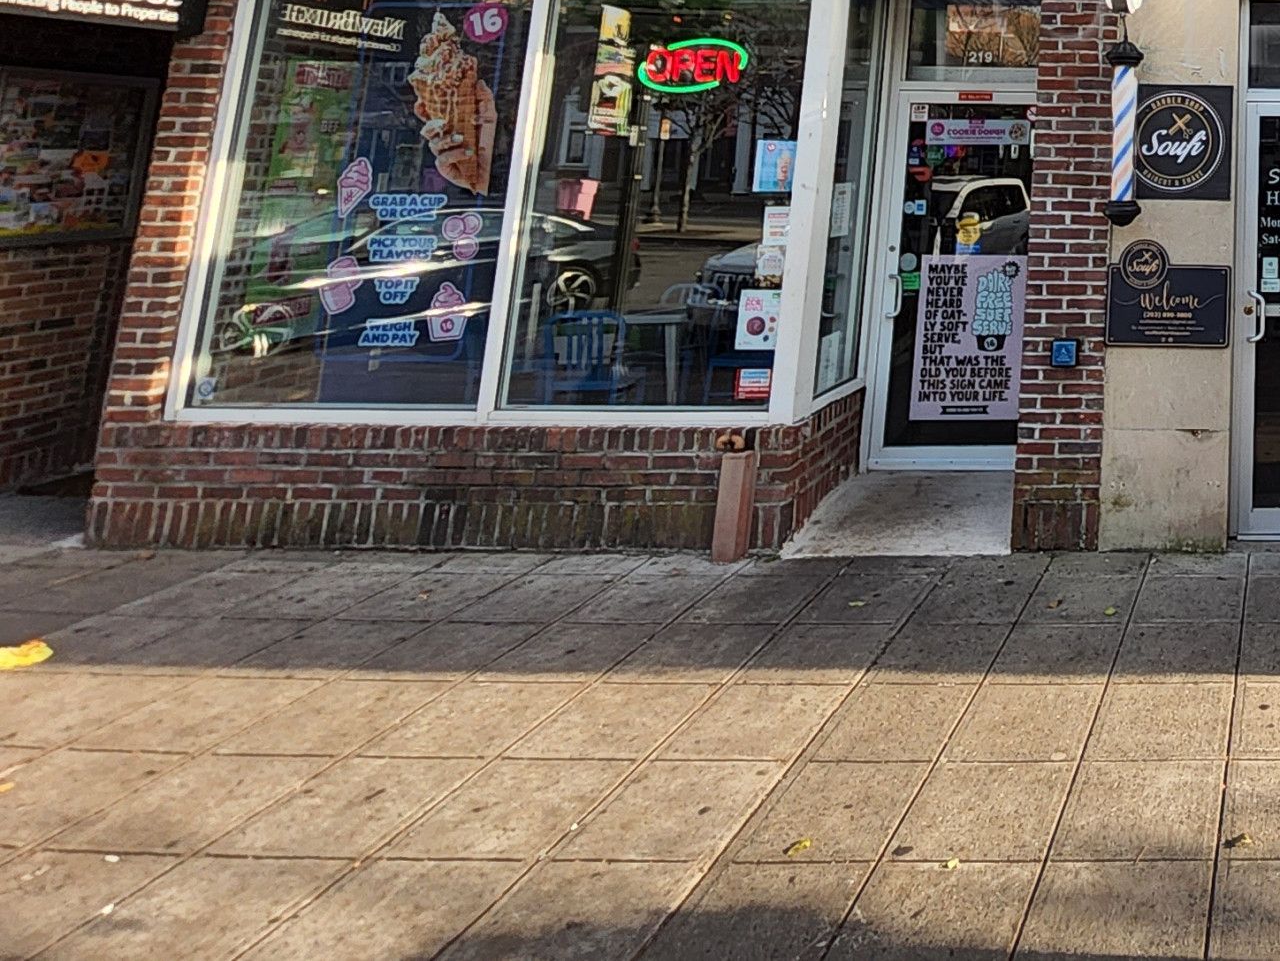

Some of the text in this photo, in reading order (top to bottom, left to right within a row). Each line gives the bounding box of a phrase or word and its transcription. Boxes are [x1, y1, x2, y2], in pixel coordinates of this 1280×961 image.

[104, 3, 119, 15] to
[121, 2, 179, 22] Properties
[469, 8, 503, 36] 16
[968, 50, 993, 64] 219
[646, 47, 740, 84] OPEN
[1141, 129, 1207, 164] Soufi
[372, 197, 445, 207] GRAB A CUP
[379, 208, 397, 218] OR
[370, 239, 435, 249] PICK YOUR
[372, 250, 430, 260] FLAVORS
[928, 264, 968, 275] MAYBE
[377, 279, 416, 289] TOP IT
[928, 275, 968, 286] YOU'VE
[382, 291, 409, 301] OFF
[926, 287, 963, 297] NEVER
[1140, 280, 1200, 311] Welcome
[925, 298, 962, 309] HEARD
[976, 290, 1012, 309] FREE
[925, 310, 968, 320] OF OAT-
[367, 321, 412, 332] WEIGH
[924, 321, 969, 332] LY SOFT
[971, 320, 1012, 336] SERVE
[361, 333, 417, 344] AND PAY
[923, 333, 961, 345] SERVE,
[922, 345, 945, 355] BUT
[922, 356, 1006, 367] THAT WAS THE
[920, 367, 1012, 378] OLD YOU BEFORE
[919, 379, 1010, 390] THIS SIGN CAME
[918, 391, 1008, 402] INTO YOUR LIFE.
